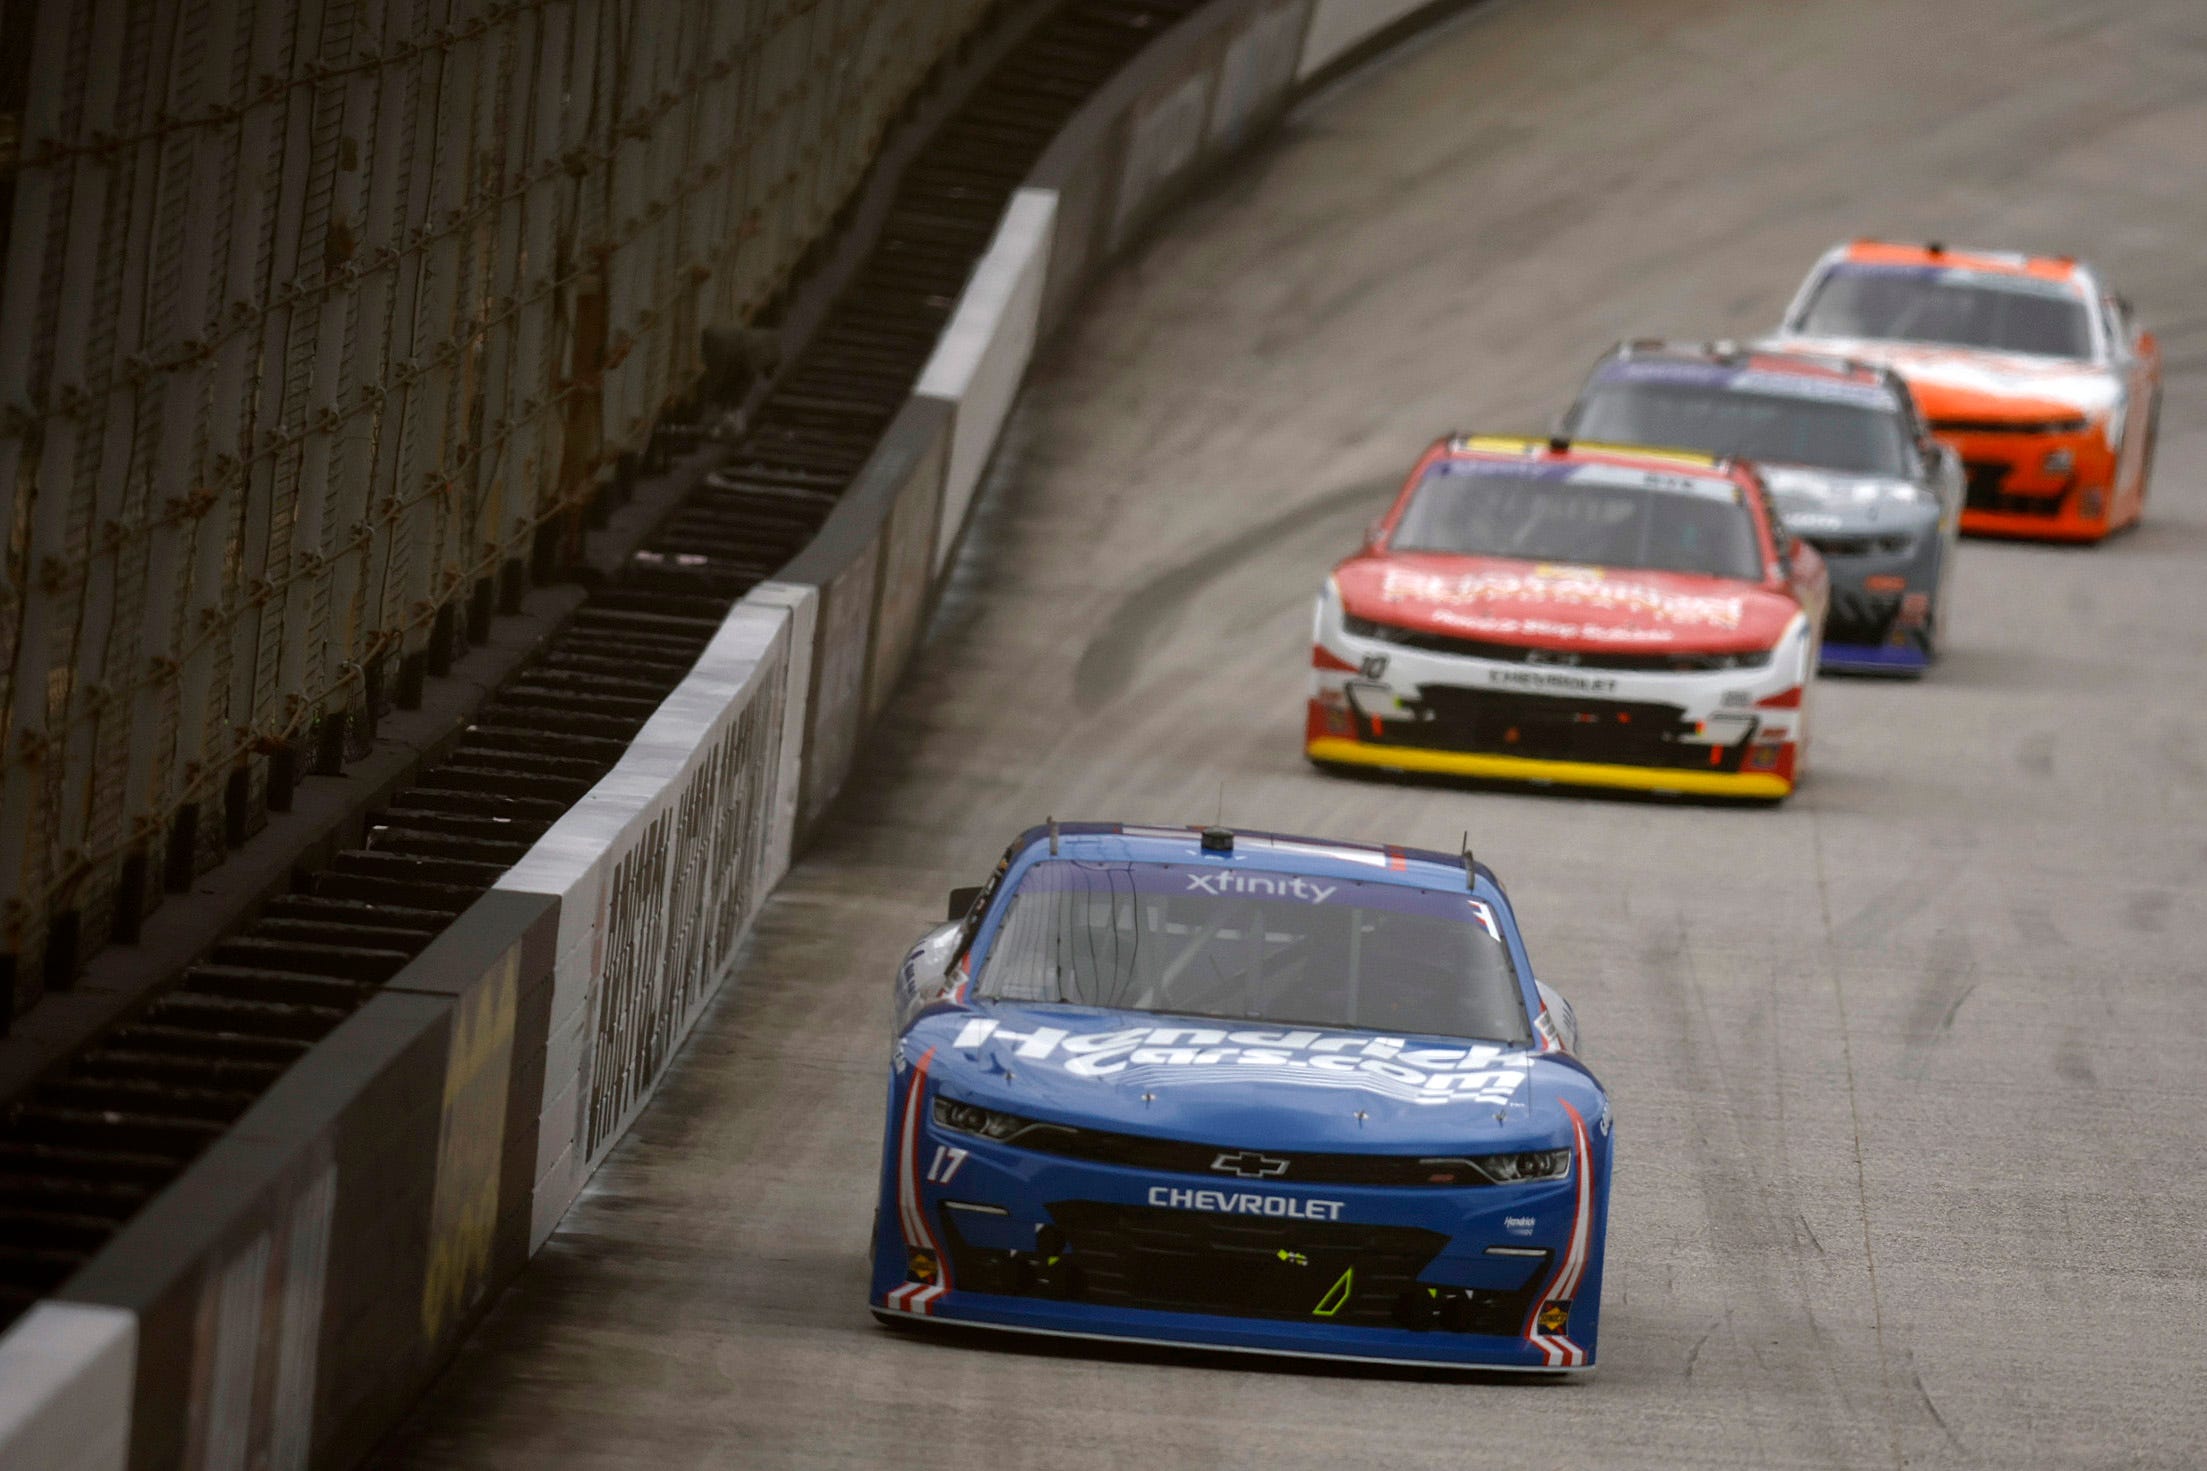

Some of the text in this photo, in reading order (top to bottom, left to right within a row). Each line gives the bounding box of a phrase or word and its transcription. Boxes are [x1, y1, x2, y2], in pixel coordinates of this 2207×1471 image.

[1360, 654, 1390, 680] 10
[1186, 870, 1337, 904] xfinity
[953, 1018, 1534, 1070] Hendrick
[927, 1145, 969, 1185] 17
[1149, 1186, 1345, 1220] CHEVROLET
